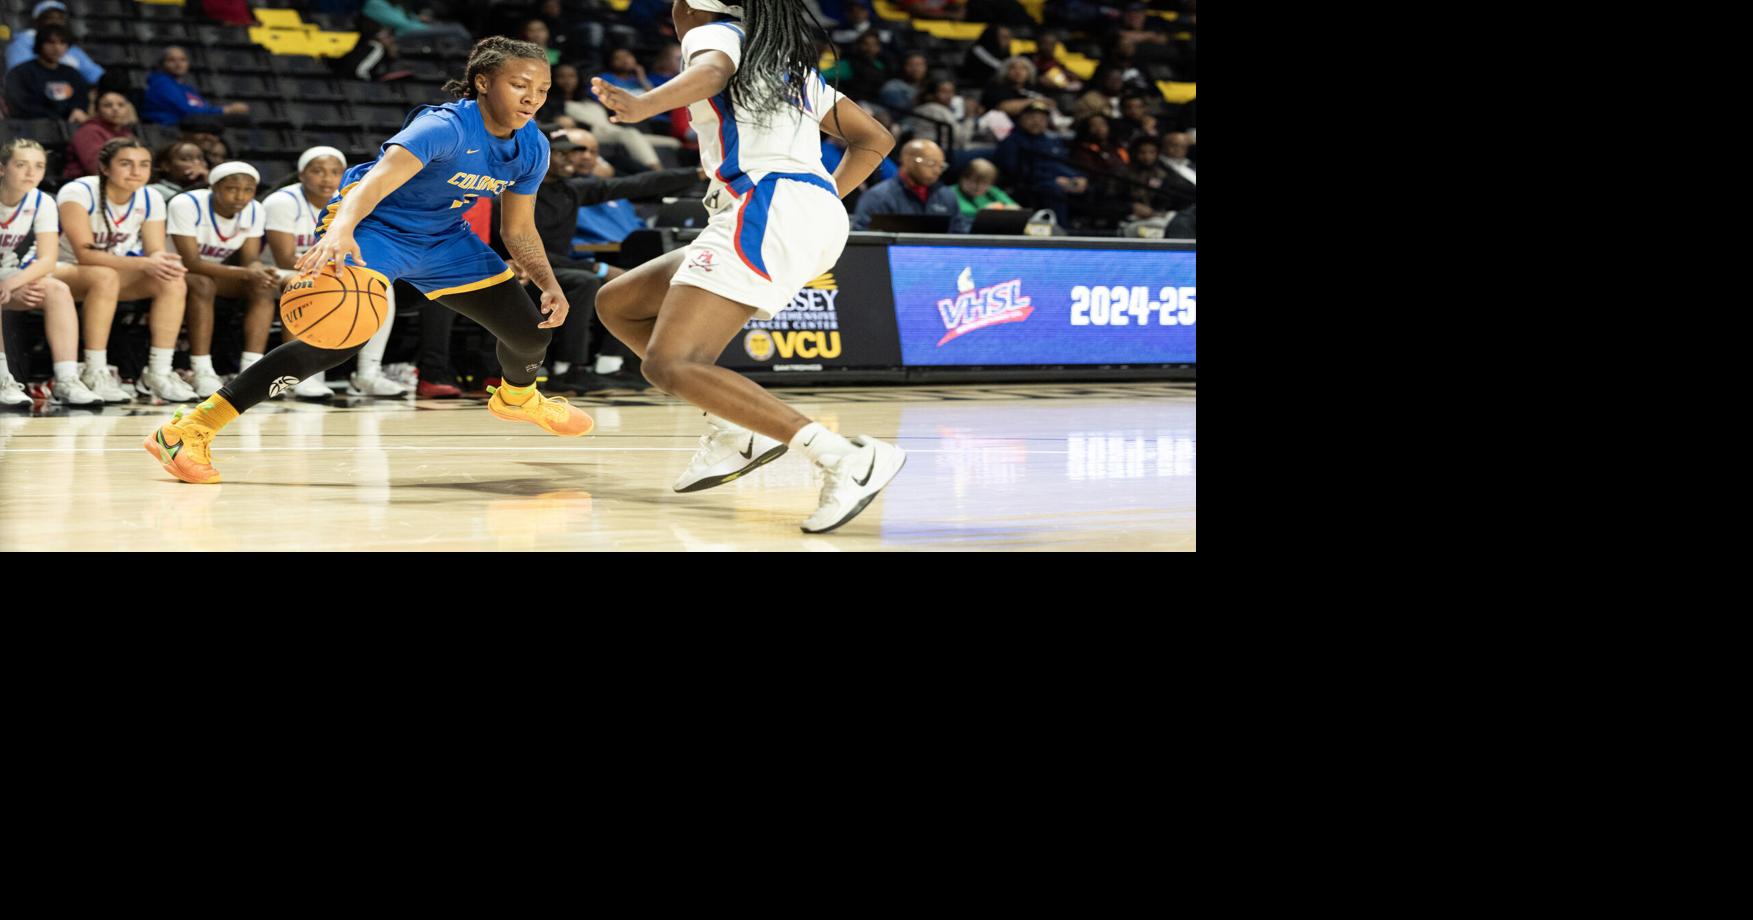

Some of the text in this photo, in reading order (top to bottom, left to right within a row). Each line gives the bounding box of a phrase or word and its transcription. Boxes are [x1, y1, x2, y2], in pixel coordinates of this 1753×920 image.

[937, 278, 1031, 329] VHSL
[1070, 285, 1196, 326] 2024-25
[771, 330, 842, 359] VCU
